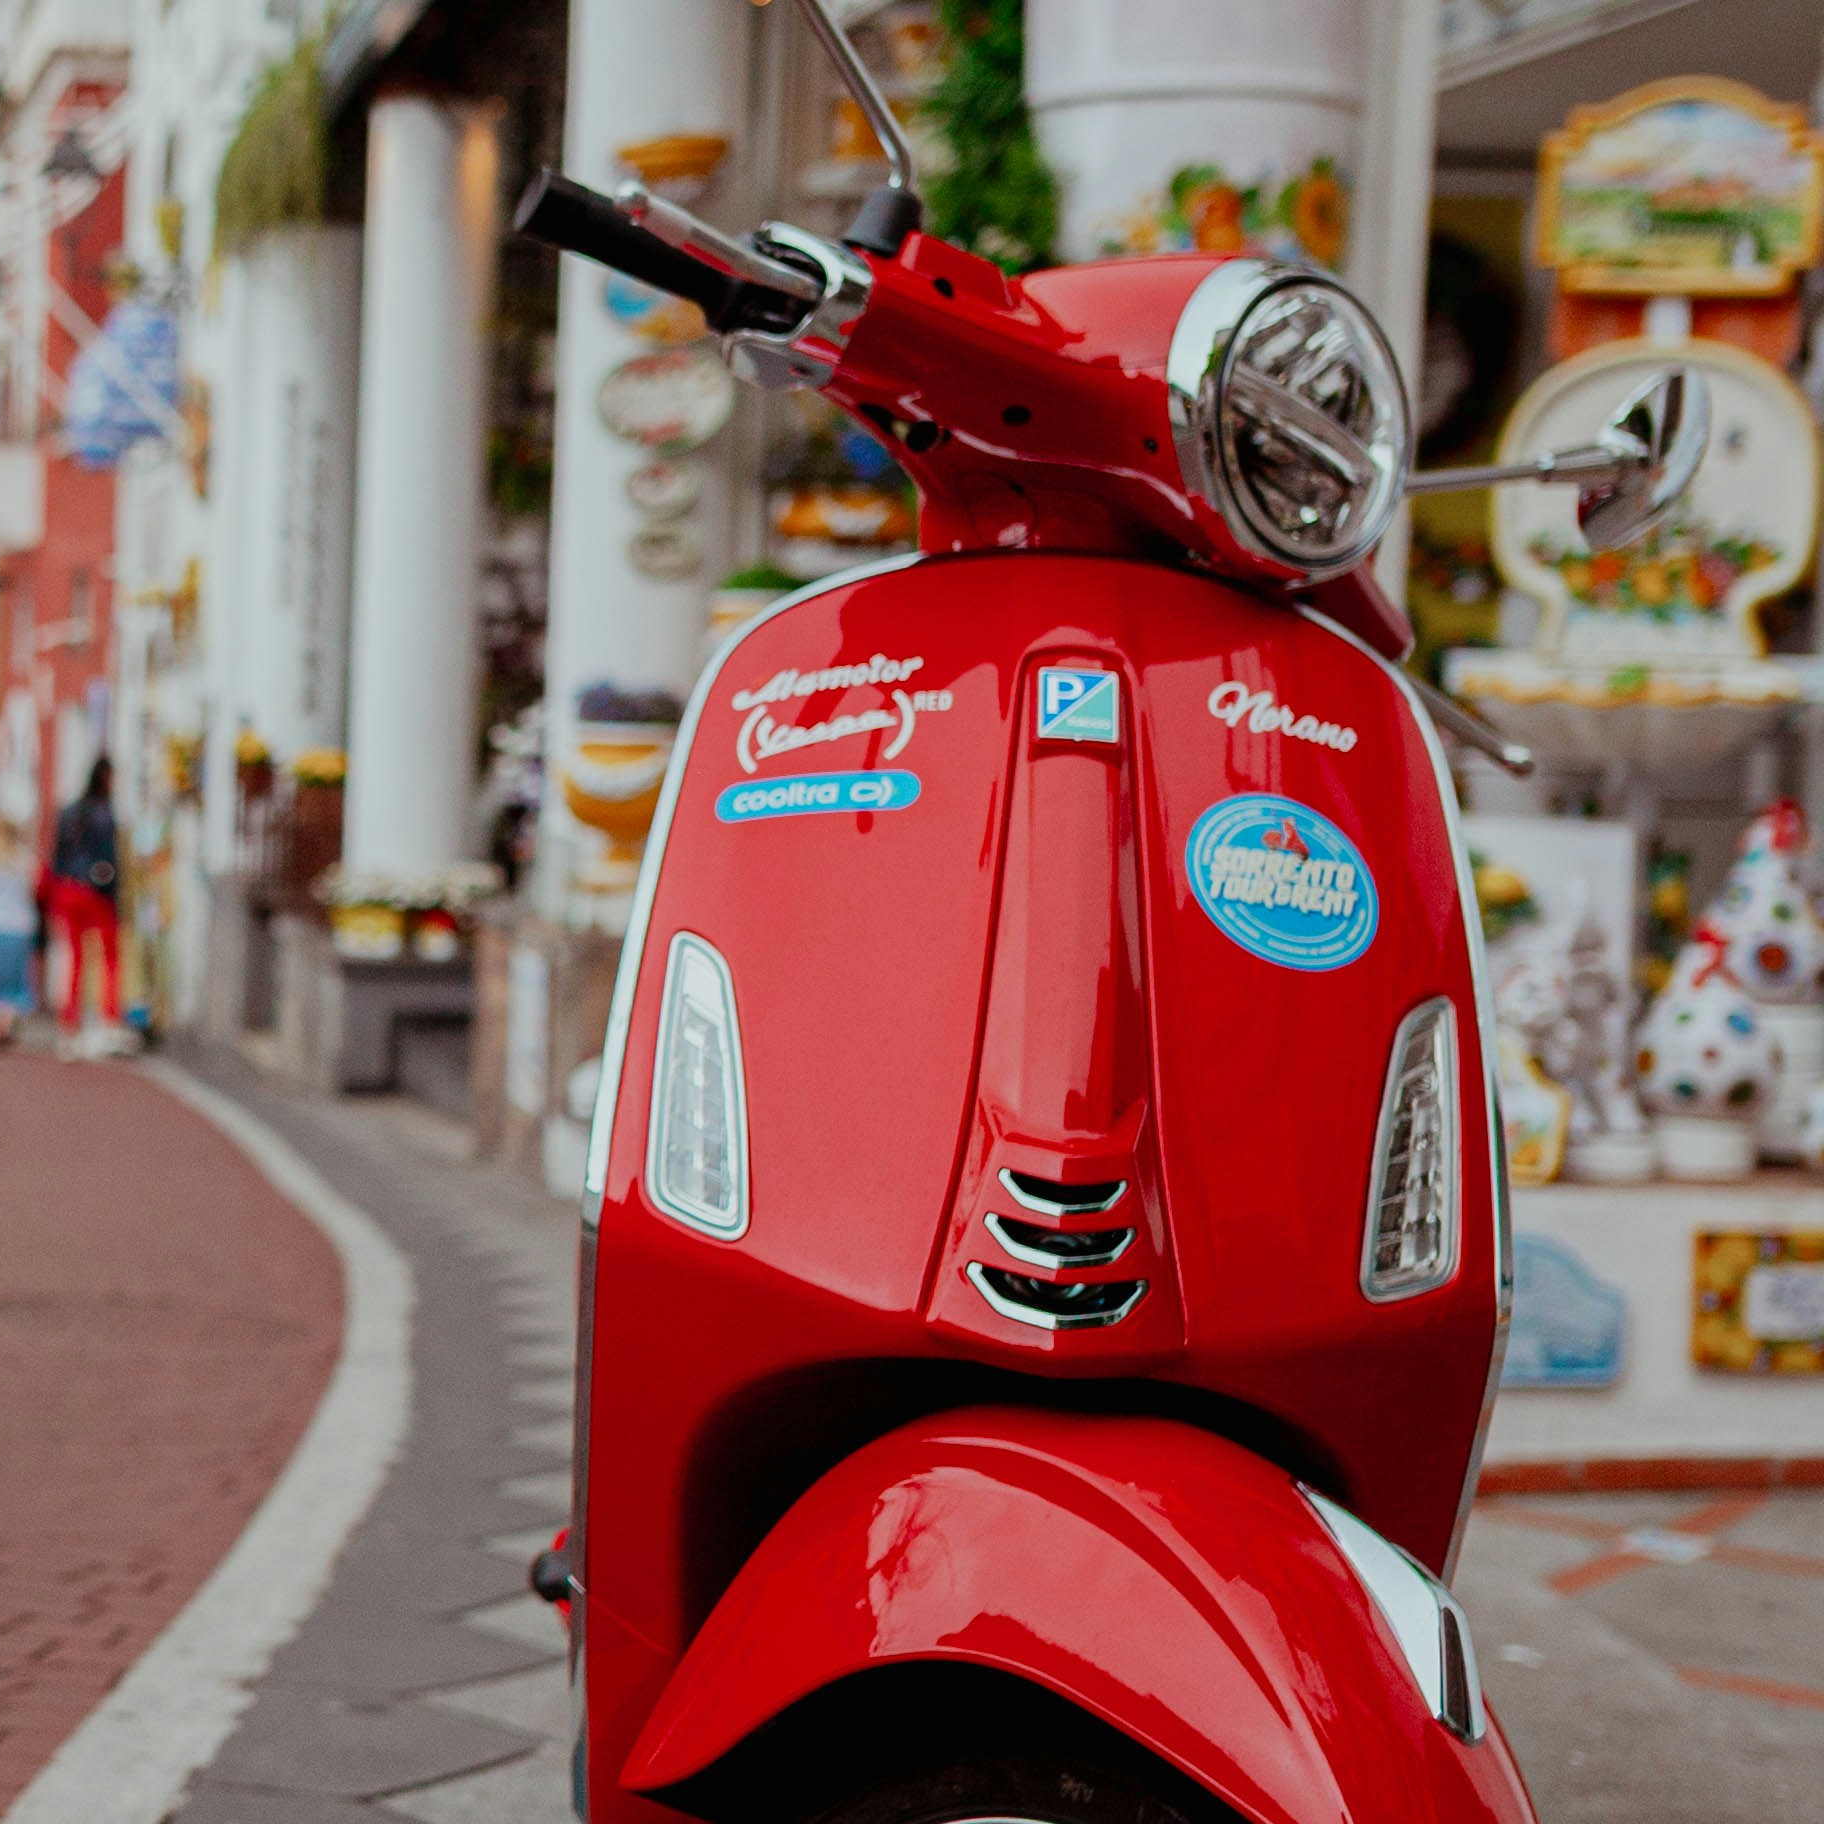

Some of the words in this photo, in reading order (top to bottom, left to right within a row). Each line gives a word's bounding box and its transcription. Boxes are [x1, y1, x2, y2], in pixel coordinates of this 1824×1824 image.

[913, 690, 953, 712] RED
[1046, 675, 1085, 715] P
[1207, 680, 1358, 753] Nerano
[732, 781, 840, 814] cooltra
[1211, 844, 1356, 892] SORRENTO
